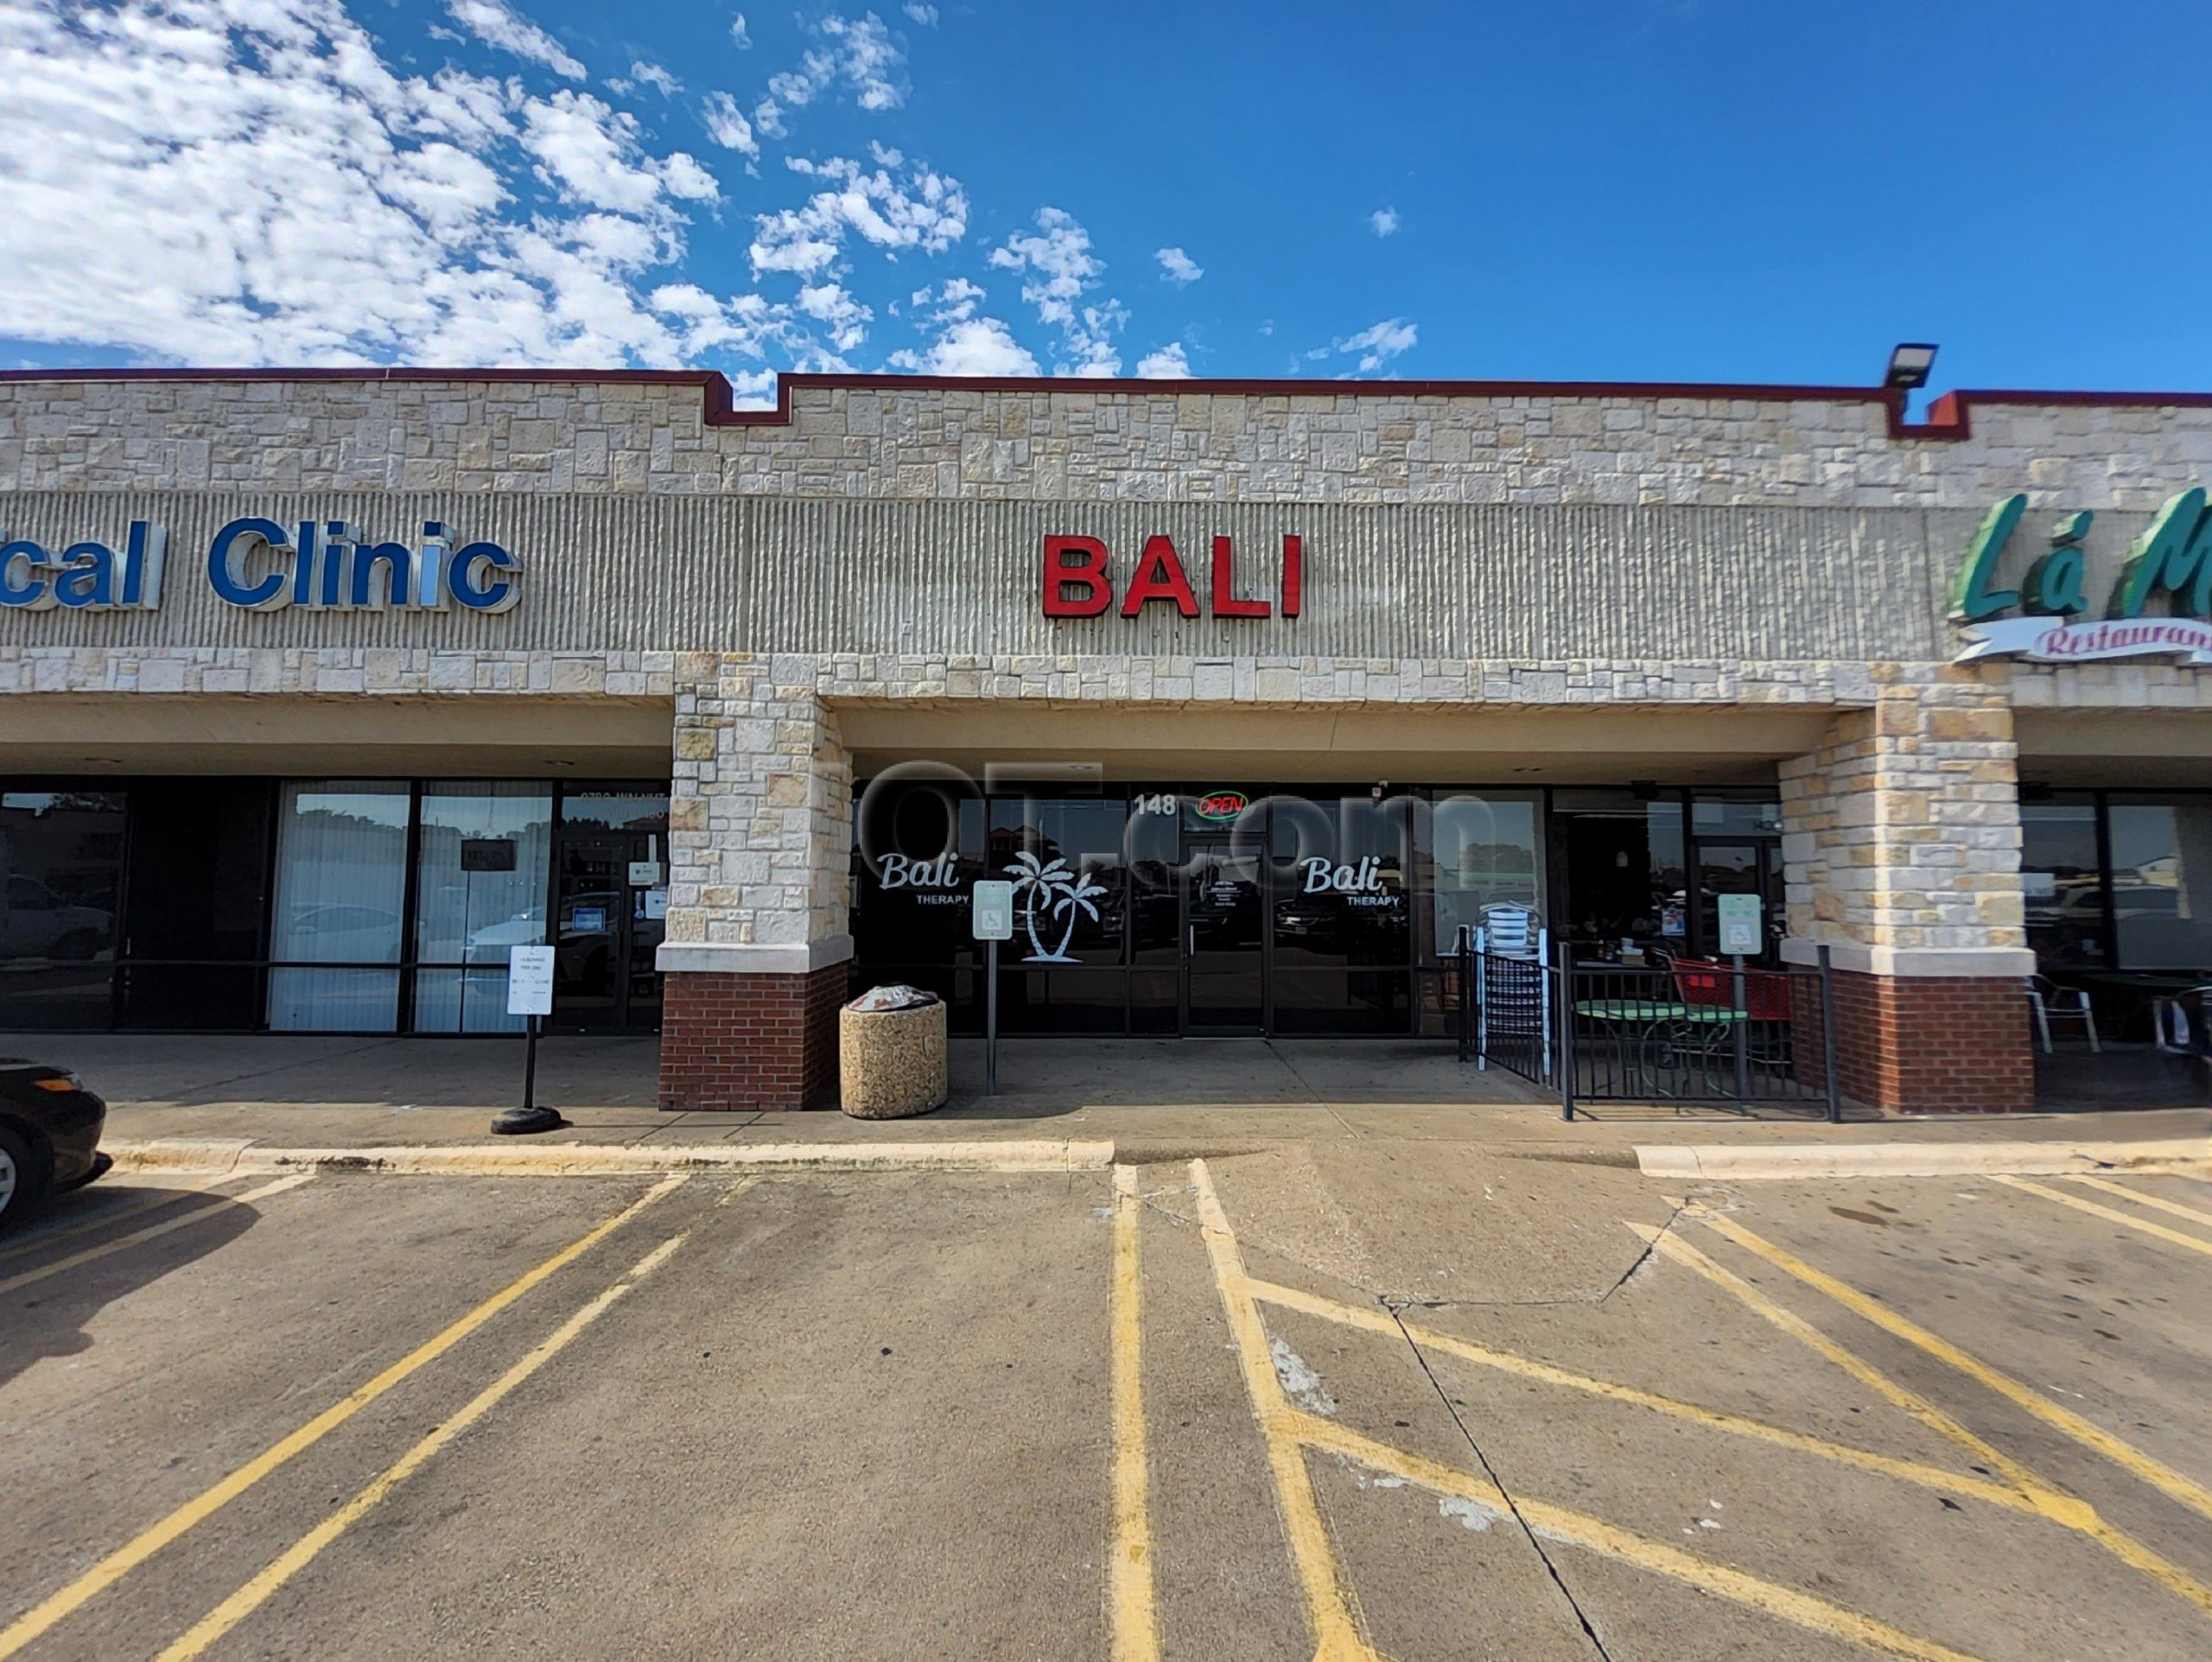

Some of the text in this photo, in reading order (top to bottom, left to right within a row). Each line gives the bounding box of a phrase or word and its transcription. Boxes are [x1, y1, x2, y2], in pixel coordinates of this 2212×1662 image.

[207, 517, 521, 612] Clinic
[1042, 533, 1301, 619] BALI
[2033, 624, 2212, 655] Restauran
[1134, 793, 1176, 816] 148
[1198, 795, 1244, 814] OPEN
[876, 851, 959, 890] Bali
[1300, 856, 1382, 894] Bali
[916, 895, 969, 905] THERAPY
[1347, 896, 1400, 907] THERAPY
